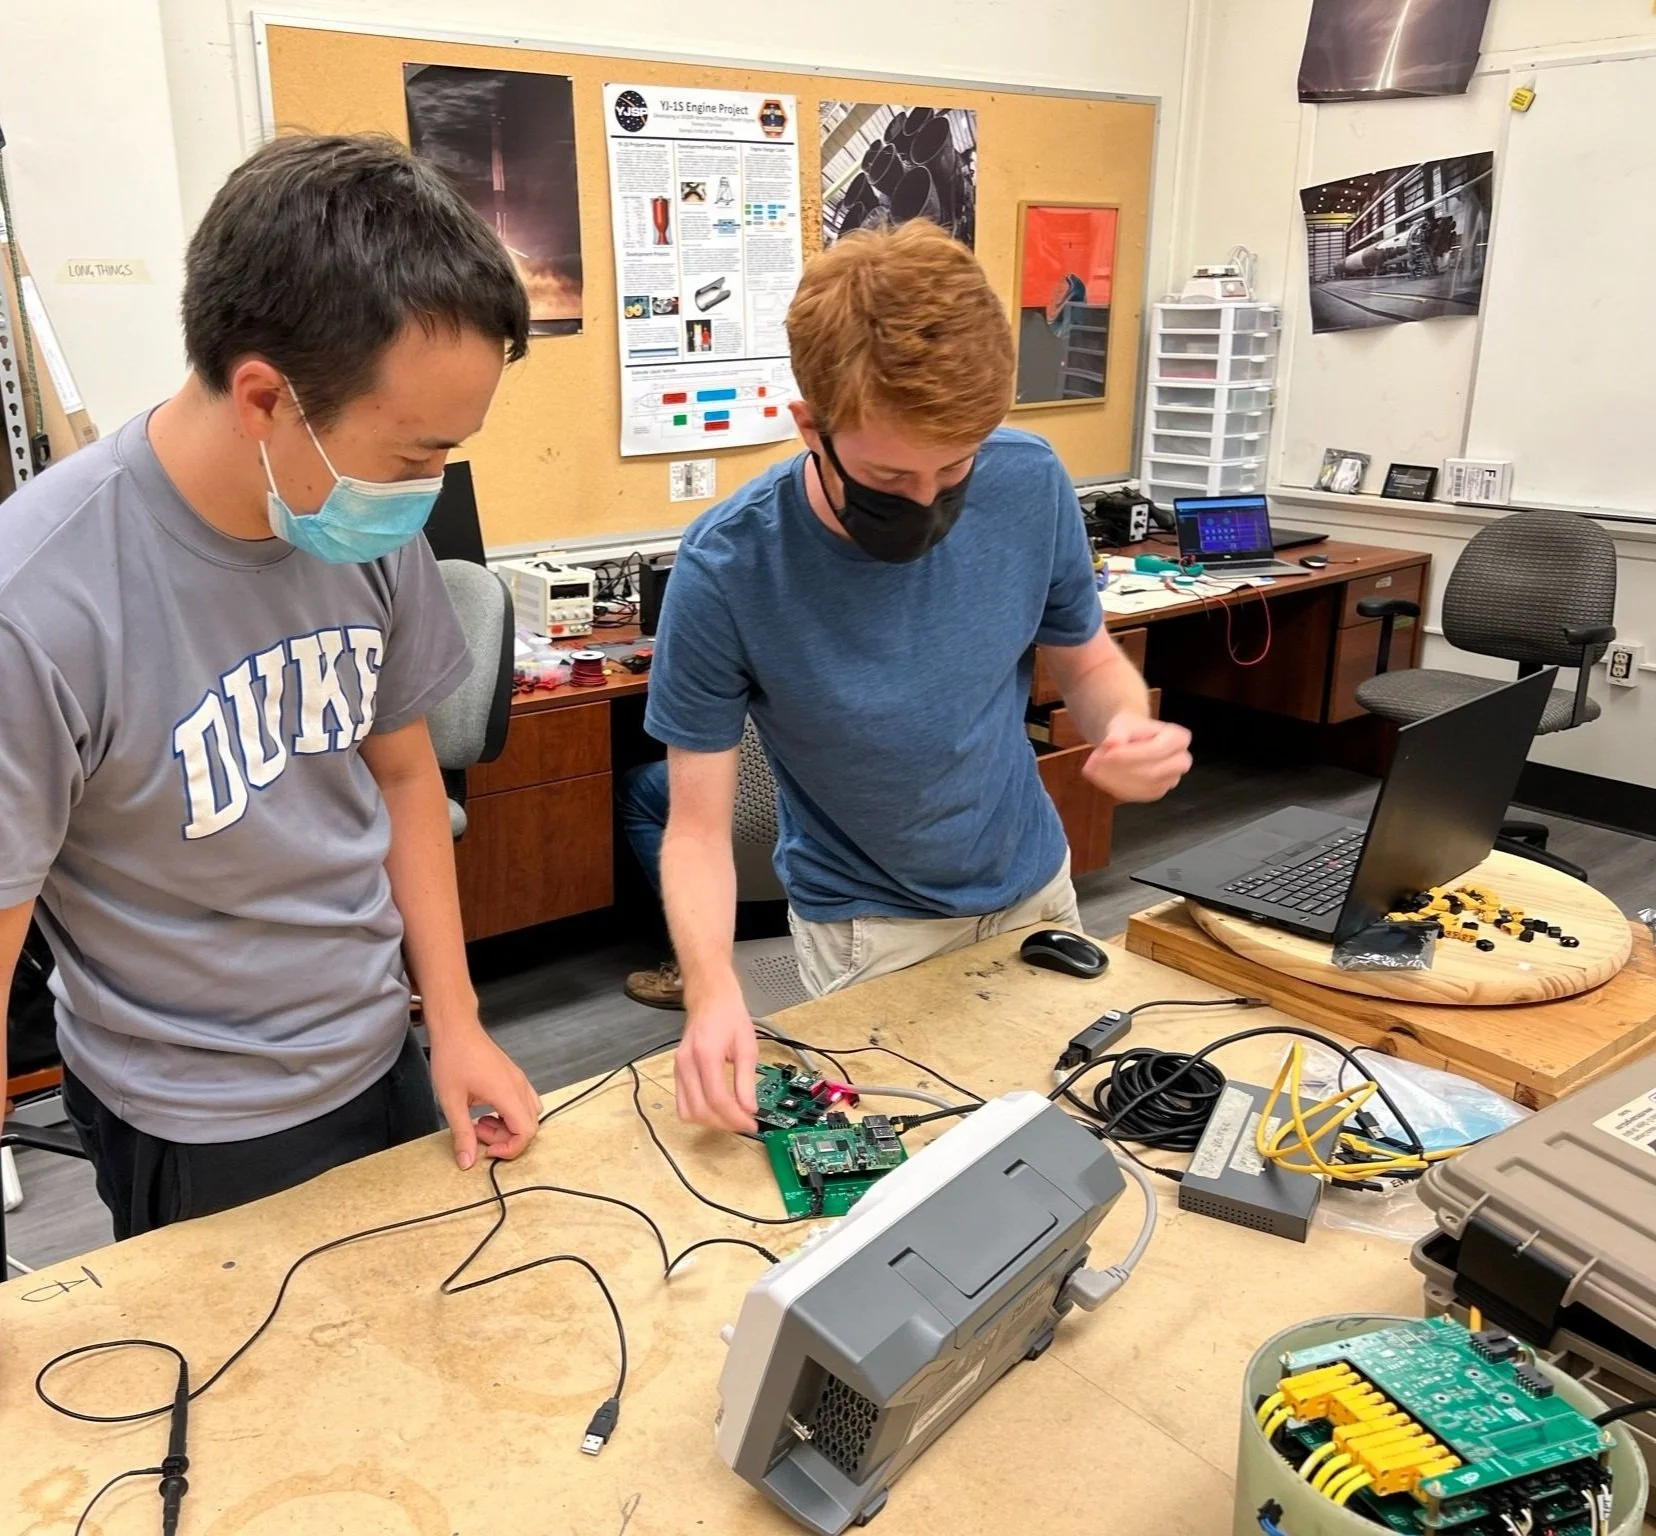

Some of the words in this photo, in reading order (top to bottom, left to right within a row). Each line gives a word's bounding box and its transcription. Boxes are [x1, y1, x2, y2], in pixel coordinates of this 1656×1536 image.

[615, 106, 648, 117] YJSP
[660, 100, 684, 112] YJ-1S
[686, 101, 717, 115] Engine
[718, 103, 749, 117] Project
[68, 264, 95, 278] LONG
[95, 264, 133, 277] THINGS
[173, 624, 384, 841] DUKE
